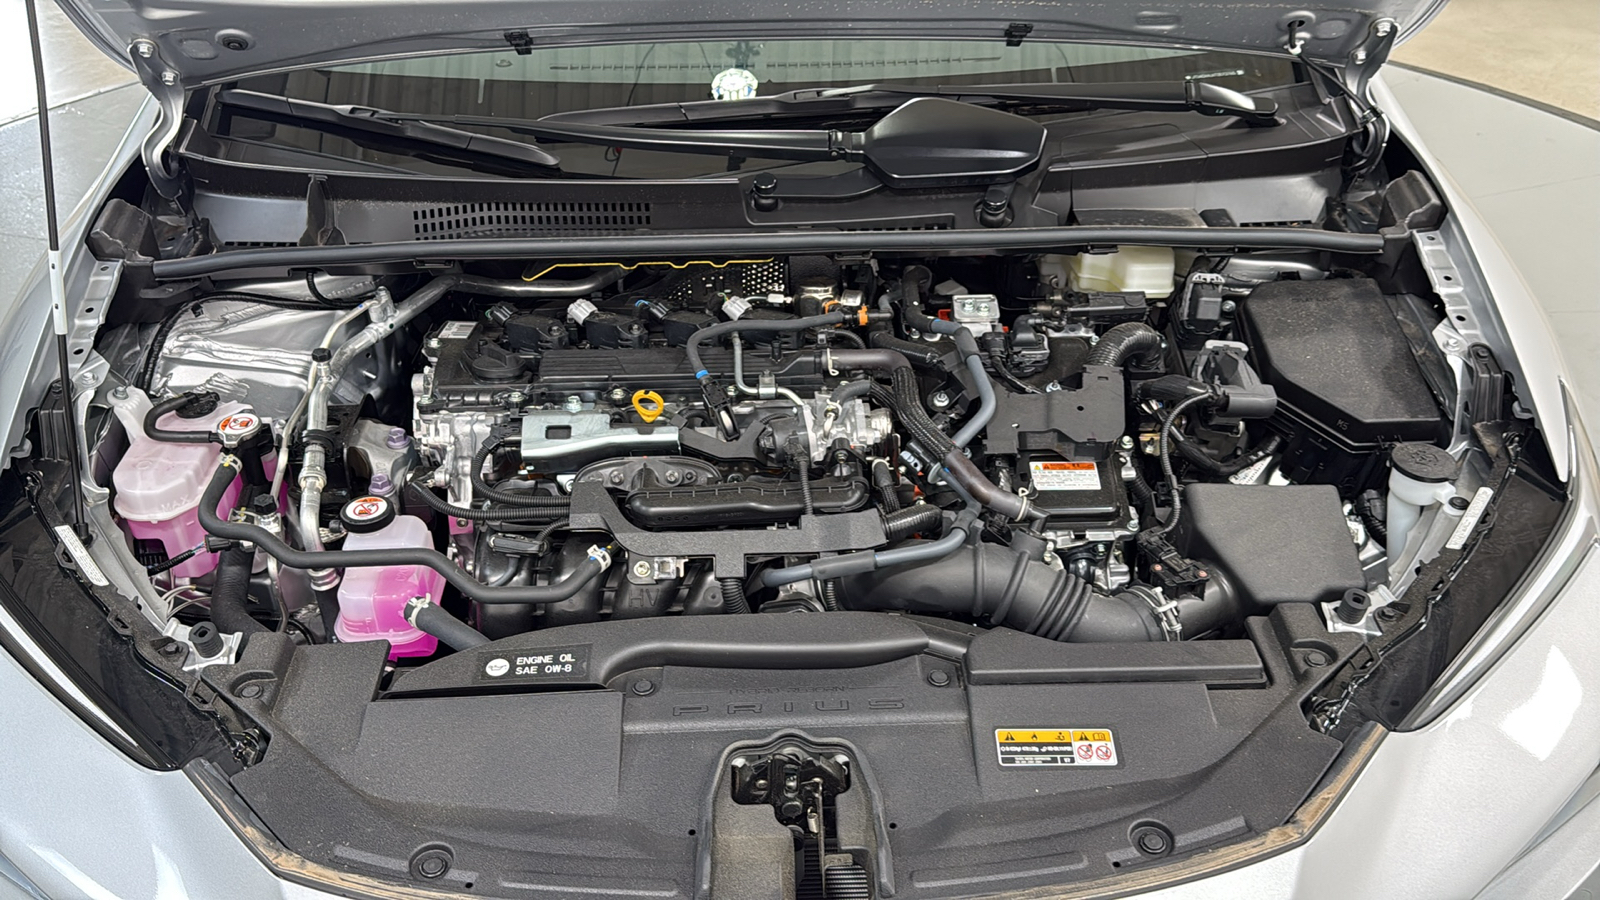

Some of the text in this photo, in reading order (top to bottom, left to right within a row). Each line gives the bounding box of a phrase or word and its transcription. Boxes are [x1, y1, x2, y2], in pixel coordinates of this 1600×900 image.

[161, 495, 191, 512] MAX
[629, 588, 660, 607] HV
[516, 653, 576, 665] ENGINE OIL
[515, 666, 538, 675] SAE
[673, 698, 905, 717] PRIUS
